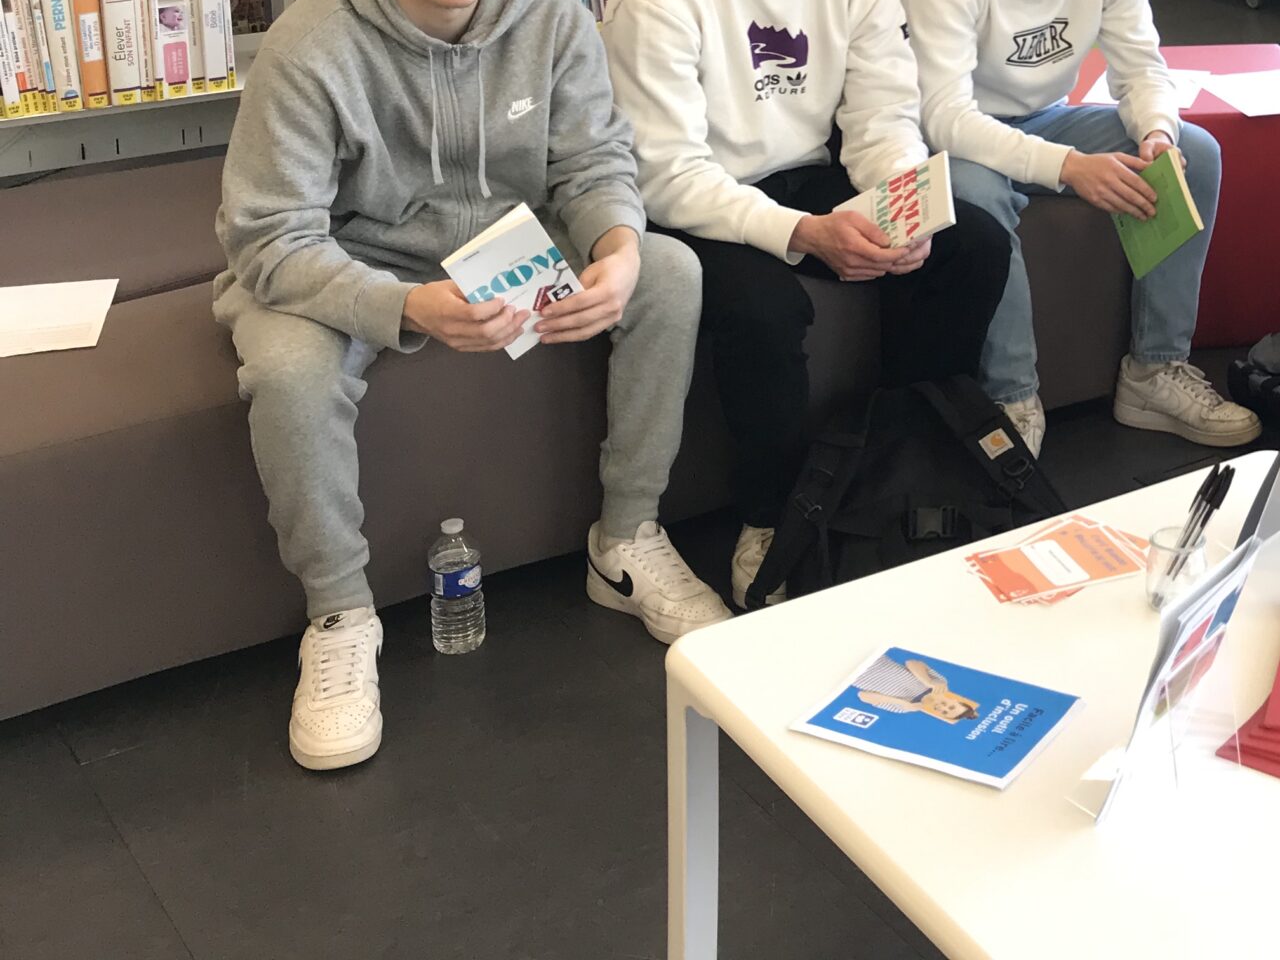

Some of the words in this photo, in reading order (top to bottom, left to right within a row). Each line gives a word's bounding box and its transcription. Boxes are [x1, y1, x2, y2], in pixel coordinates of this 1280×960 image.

[59, 36, 68, 54] enfant
[112, 26, 126, 61] Élever
[124, 19, 133, 48] ENFANT
[126, 50, 134, 66] SON
[512, 96, 533, 113] NIKE
[875, 179, 888, 234] PARO
[888, 176, 904, 224] DAN
[466, 246, 564, 304] ROOM
[965, 698, 1010, 742] d'inclusion
[1009, 702, 1028, 717] Un
[1015, 706, 1044, 732] Facile
[991, 714, 1014, 734] outil
[987, 735, 1016, 757] lire...
